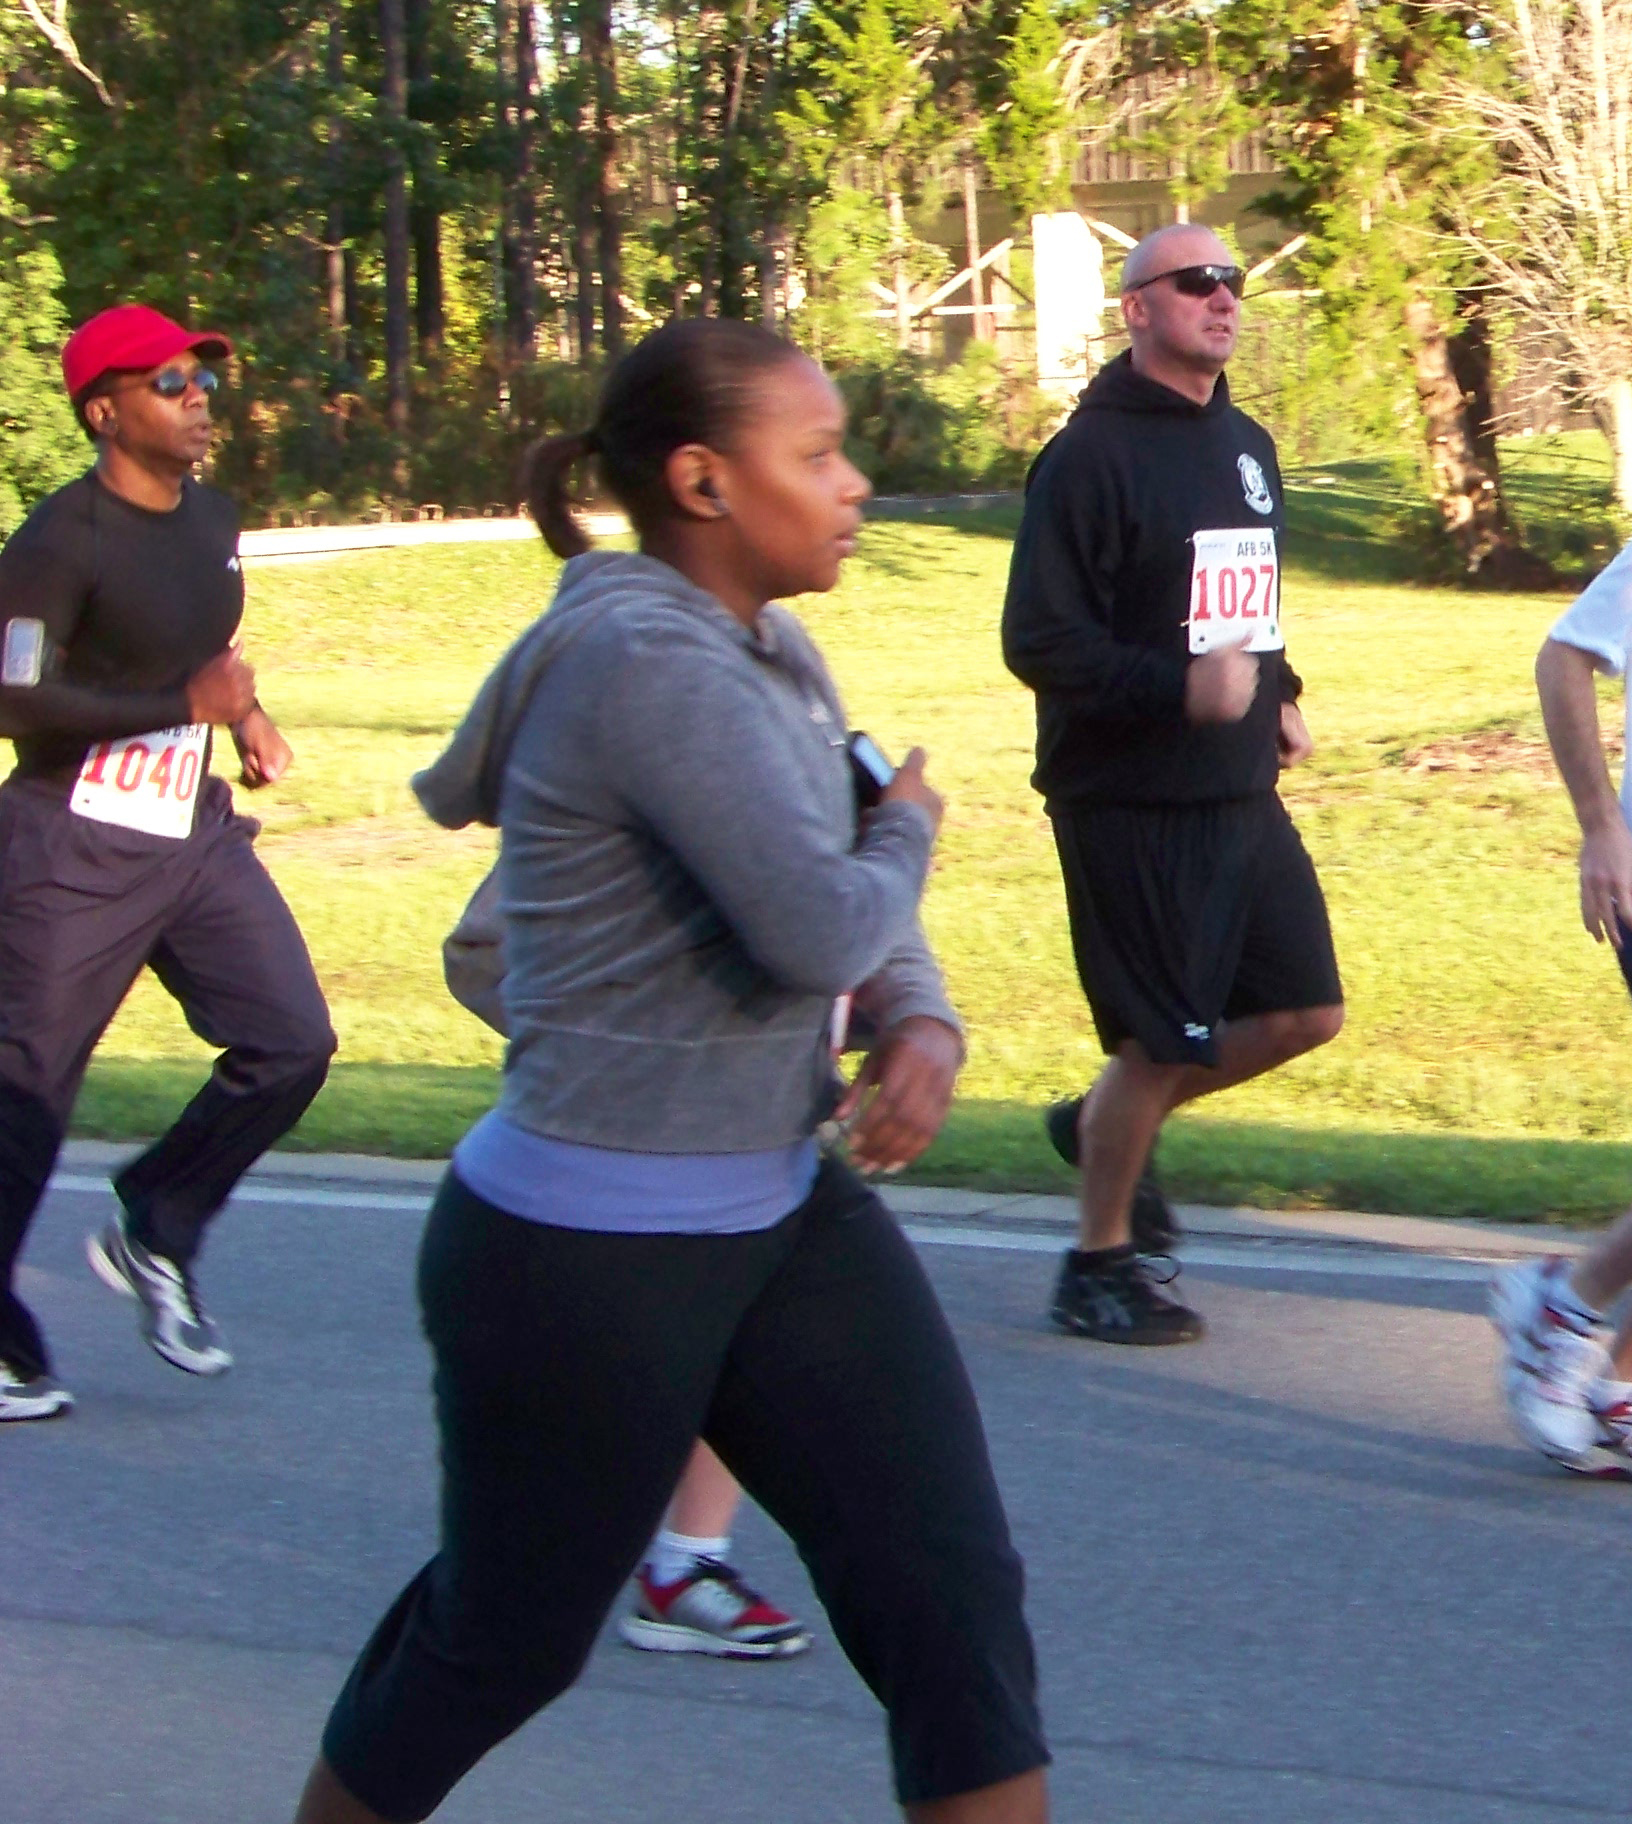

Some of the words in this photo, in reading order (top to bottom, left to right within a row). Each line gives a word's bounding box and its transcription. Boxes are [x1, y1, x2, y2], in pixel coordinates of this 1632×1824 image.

[1237, 542, 1258, 556] AFB
[1260, 541, 1274, 555] 5K
[1194, 565, 1274, 620] 1027
[83, 740, 198, 801] 1040
